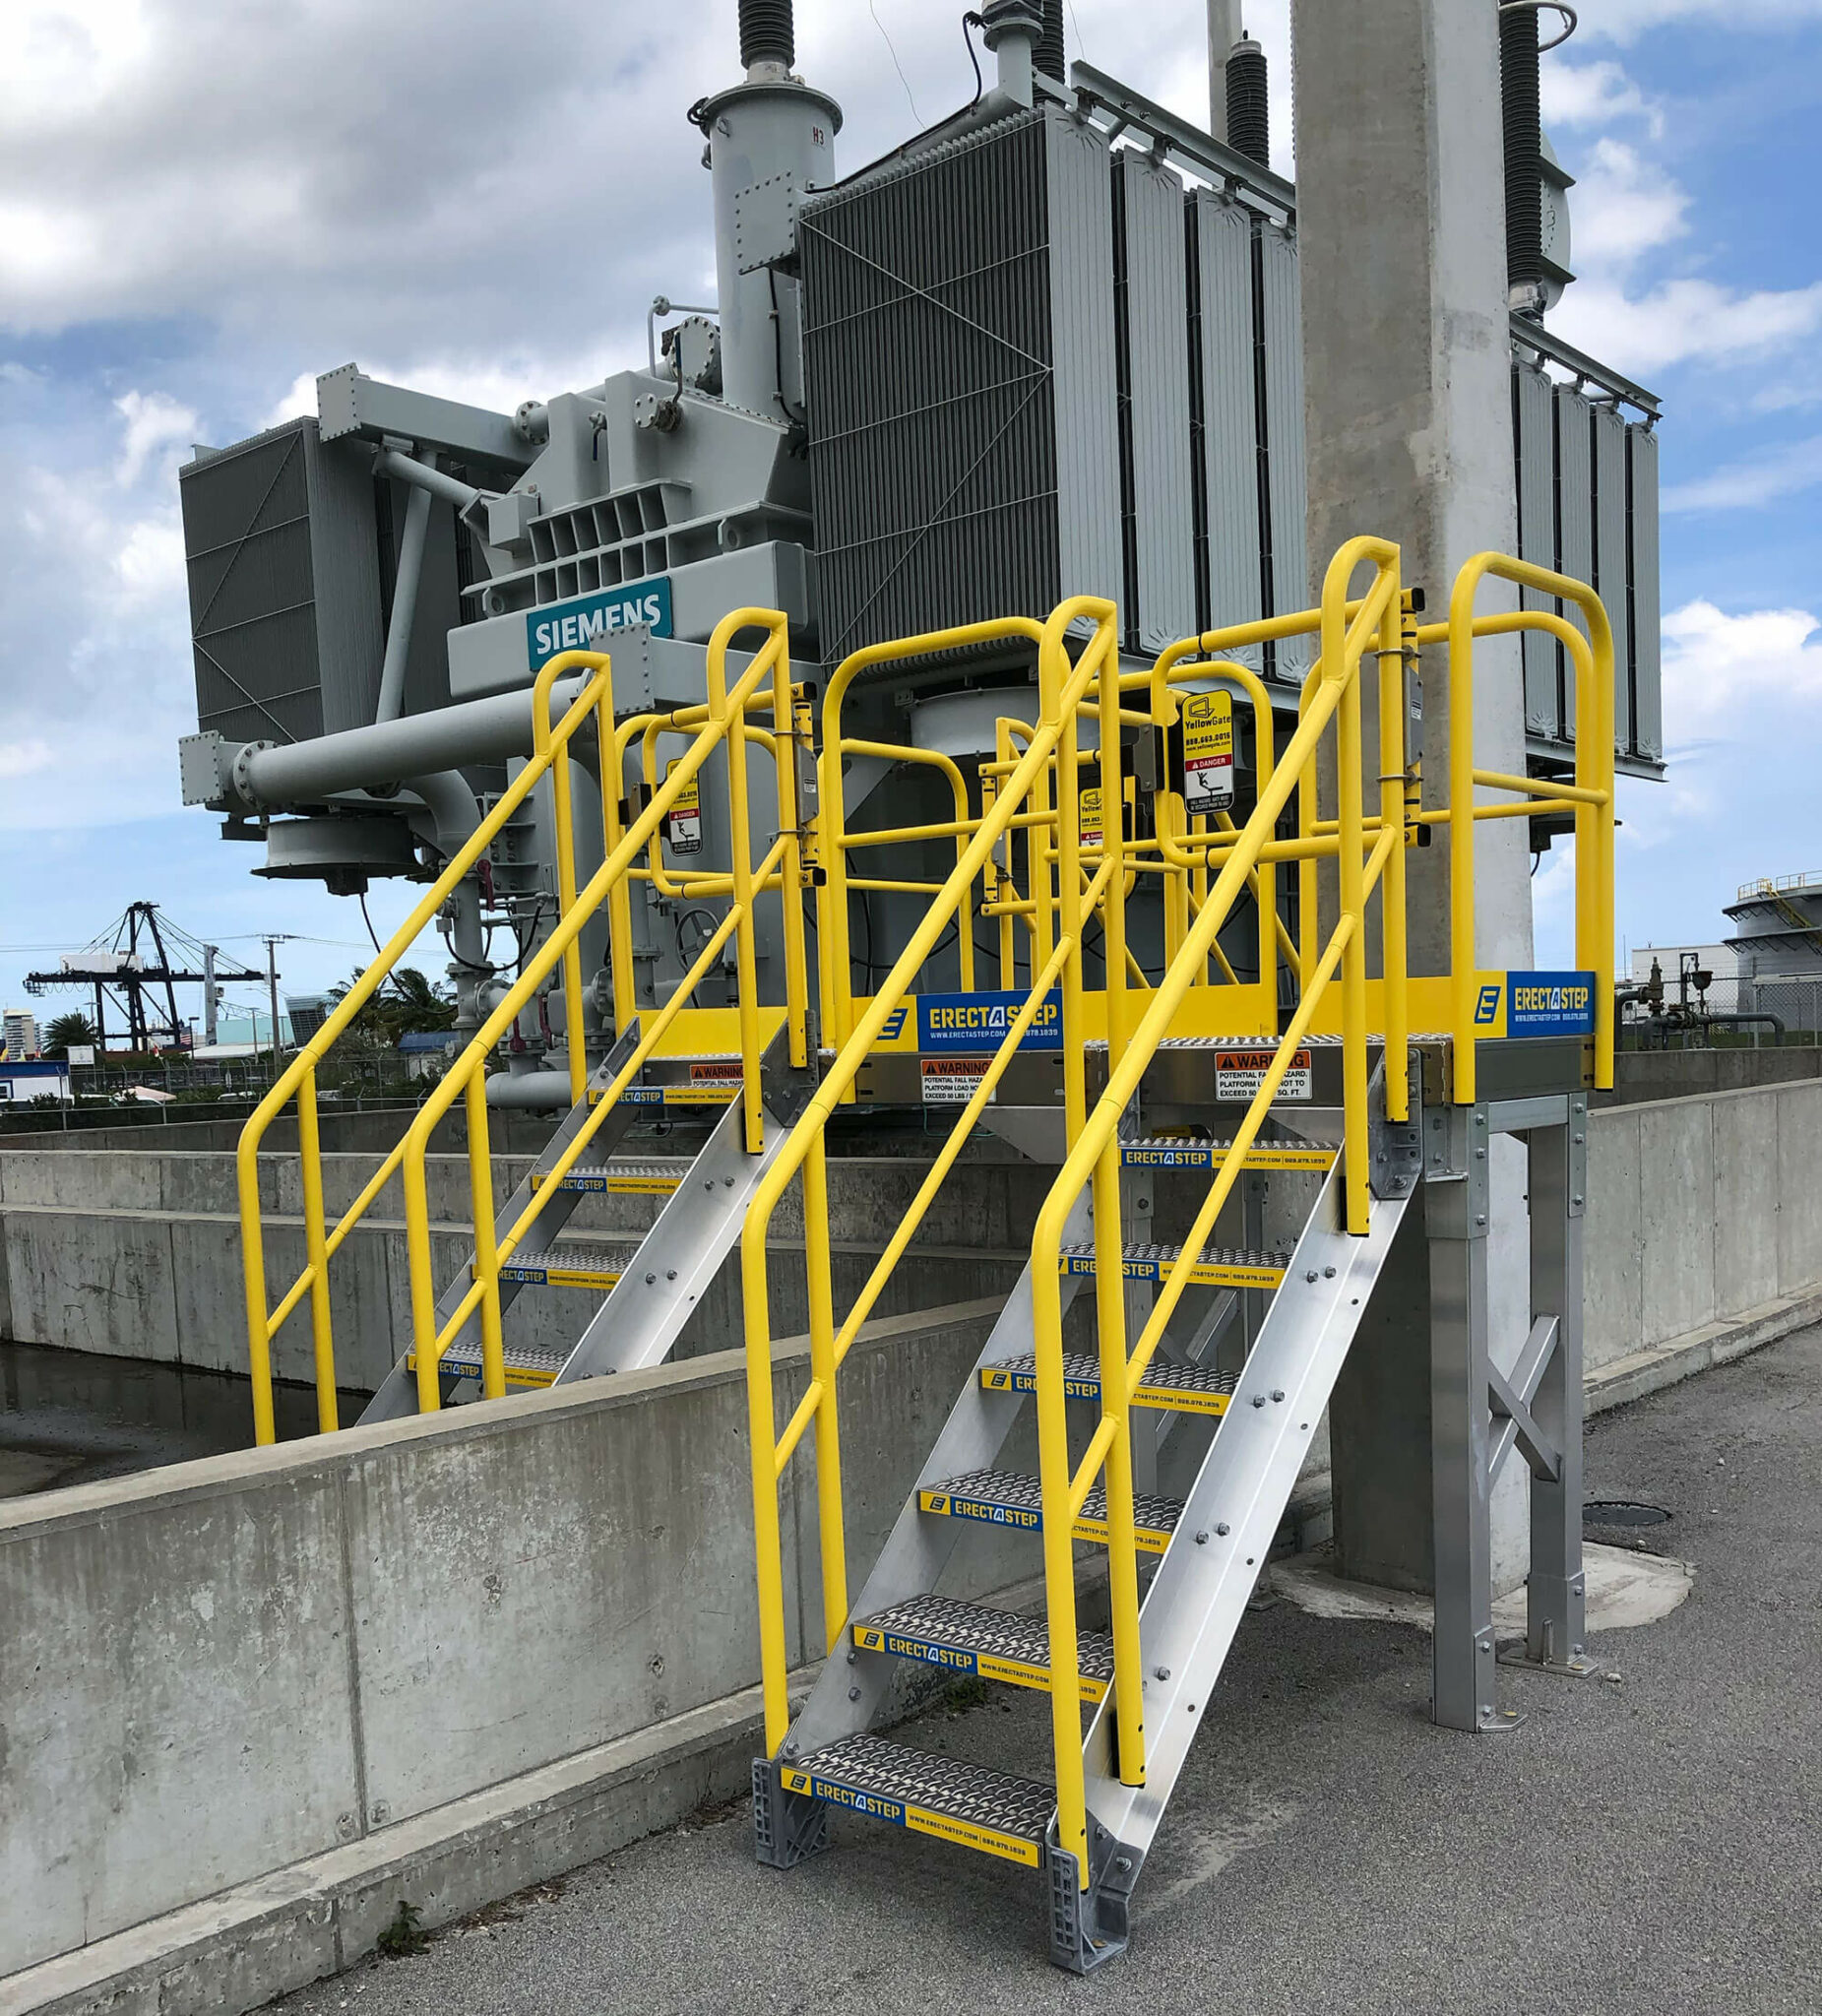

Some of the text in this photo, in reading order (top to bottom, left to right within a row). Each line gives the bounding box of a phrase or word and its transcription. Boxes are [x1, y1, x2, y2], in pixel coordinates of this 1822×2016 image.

[813, 126, 824, 145] H3
[535, 594, 661, 655] SIEMENS
[1185, 716, 1231, 729] YellowGate
[1199, 757, 1226, 768] DANGER
[1515, 987, 1588, 1010] ERECTASTEP
[1126, 1152, 1207, 1165] ERECTASTEP
[439, 1361, 479, 1377] ECTASTEP
[955, 1501, 1038, 1527] ERECTASTEP
[889, 1637, 973, 1670] ERECTASTEP
[981, 1663, 1049, 1684] WWW.ERECTASTEP.COM
[816, 1783, 901, 1820] ERECTASTEP
[910, 1814, 978, 1842] WWW.ERECTASTEP.COM
